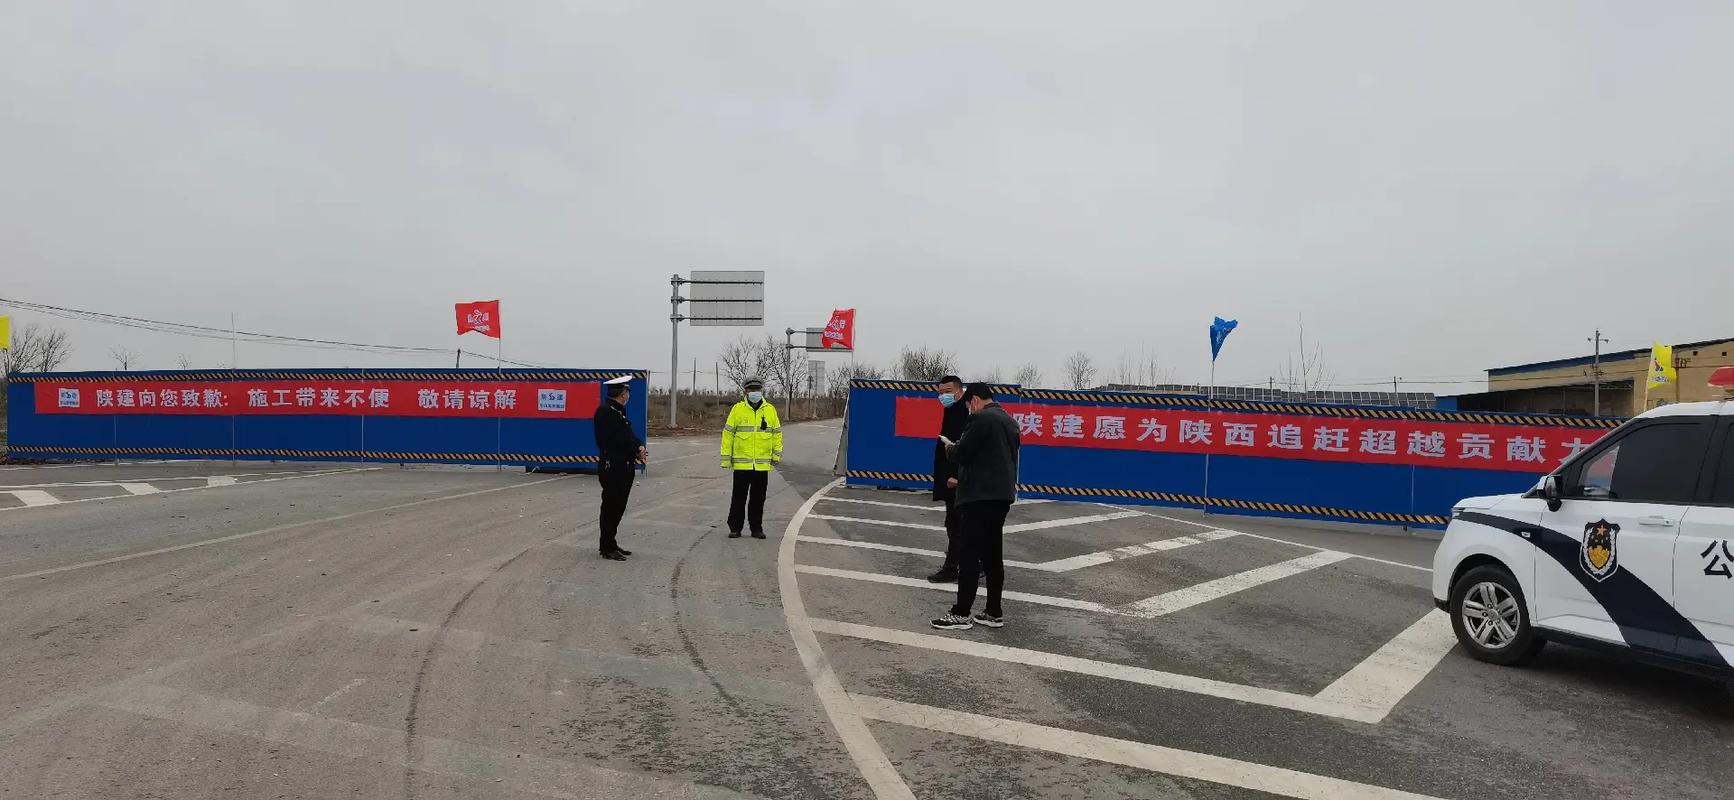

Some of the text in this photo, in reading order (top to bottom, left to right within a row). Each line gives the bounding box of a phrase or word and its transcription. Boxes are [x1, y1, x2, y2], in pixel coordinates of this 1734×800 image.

[247, 387, 390, 409] 施工带来不便
[417, 388, 517, 410] 敬请谅解
[1700, 539, 1734, 579] 公
